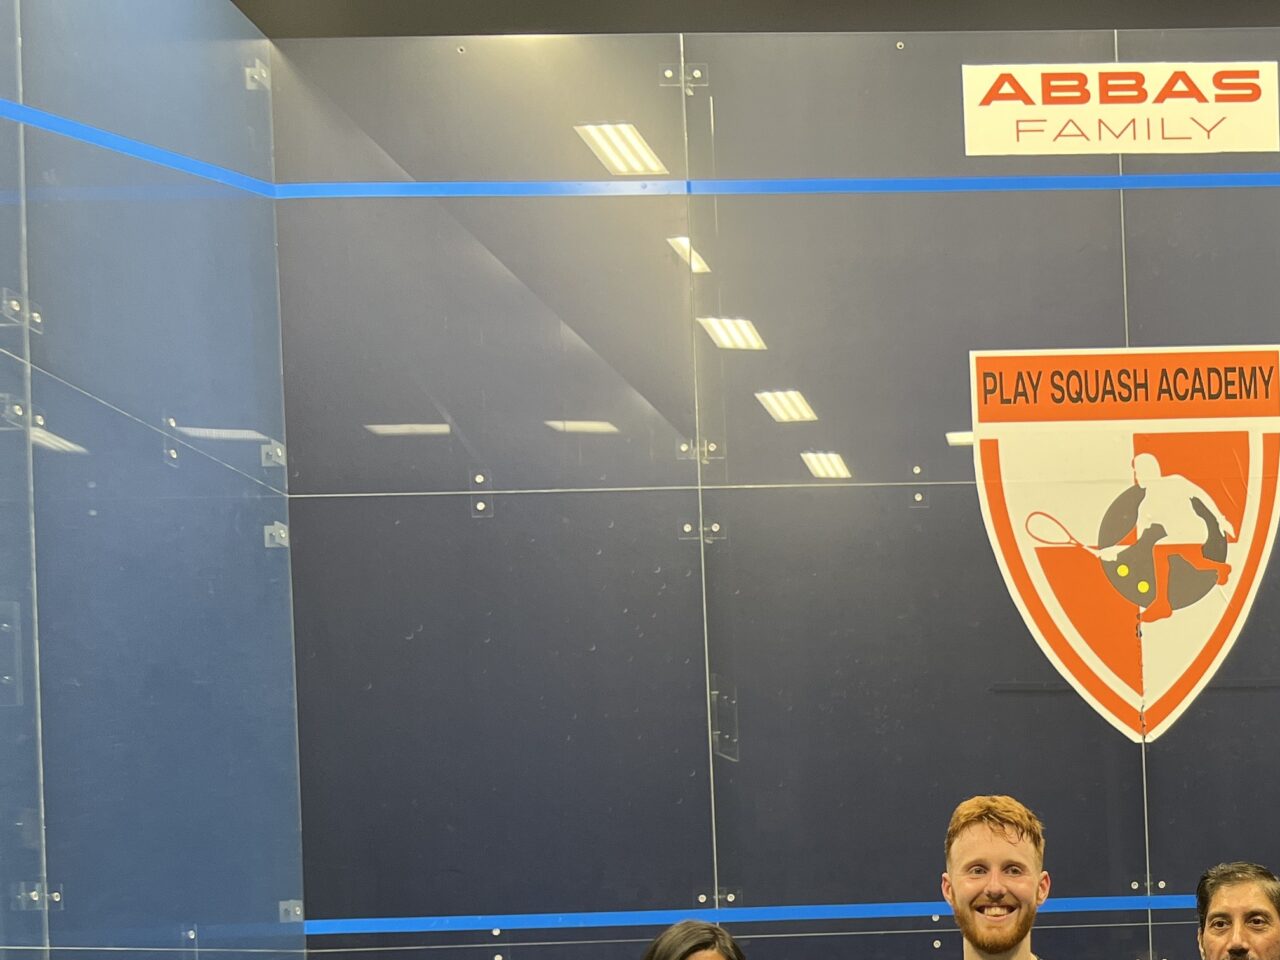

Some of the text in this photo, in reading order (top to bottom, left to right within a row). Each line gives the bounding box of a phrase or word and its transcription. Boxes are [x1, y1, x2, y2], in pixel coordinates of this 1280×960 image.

[979, 70, 1262, 106] ABBAS
[1016, 116, 1227, 142] FAMILY
[982, 365, 1275, 405] PLAY SQUASH ACADEMY
